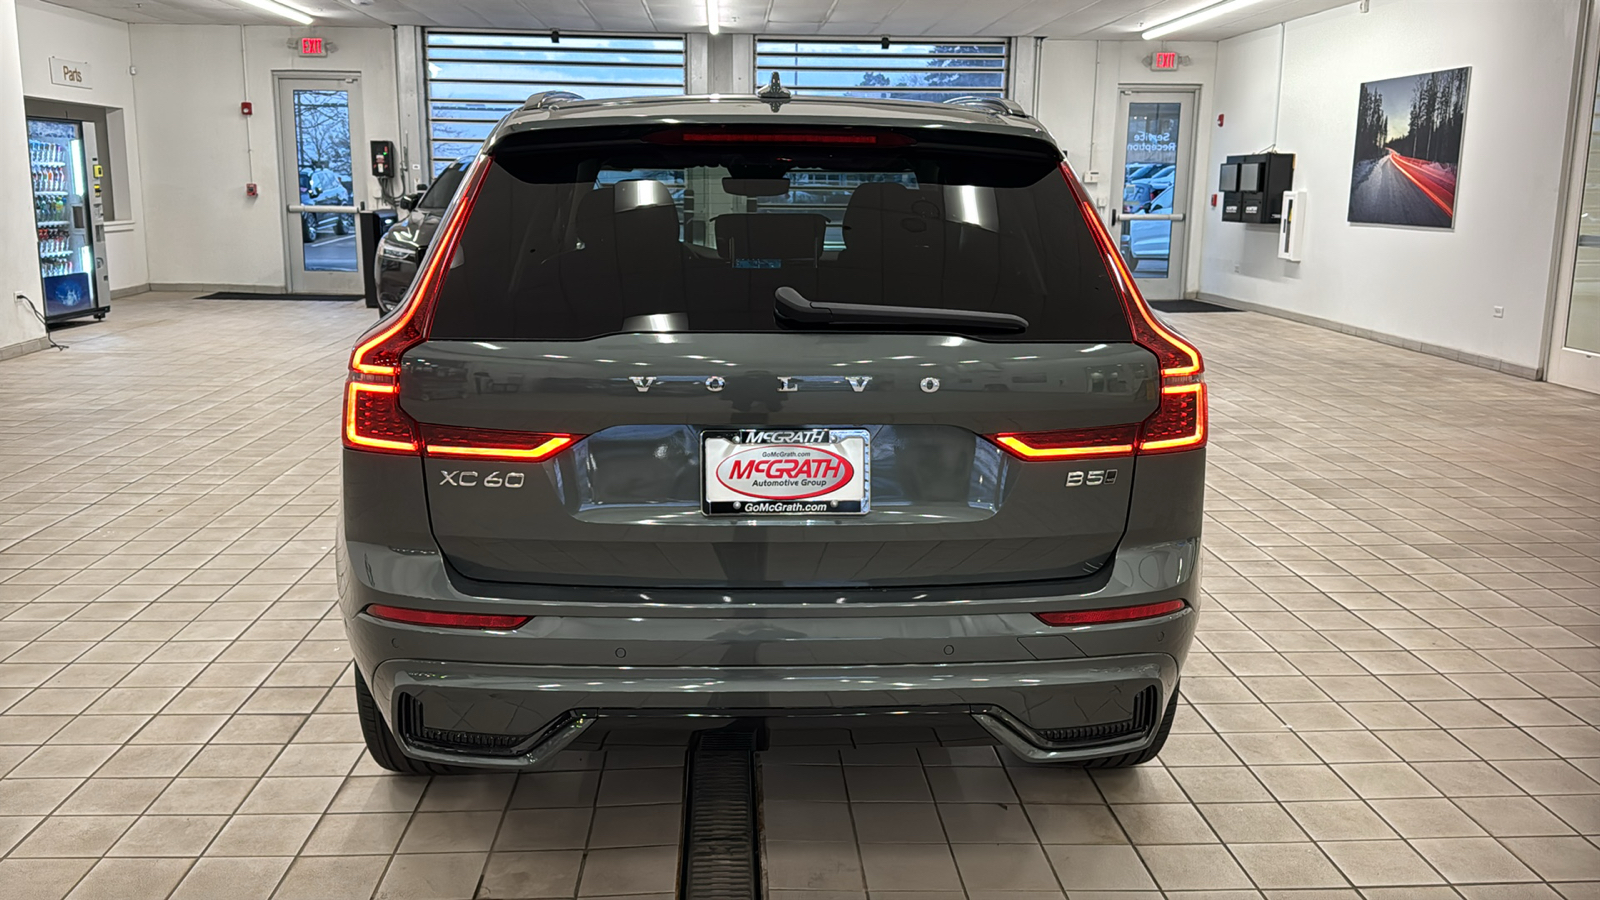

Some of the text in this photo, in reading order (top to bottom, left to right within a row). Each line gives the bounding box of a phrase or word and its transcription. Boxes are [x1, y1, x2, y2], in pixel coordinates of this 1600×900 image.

[302, 38, 322, 53] EXIT
[1156, 52, 1175, 68] EXIT
[628, 376, 940, 393] VOLVO
[745, 431, 824, 443] McGRATH
[761, 451, 811, 459] GoMcGrath.com
[728, 459, 843, 480] McGRATH
[752, 479, 827, 488] Automotive Group
[744, 501, 827, 512] GoMcGrath.com
